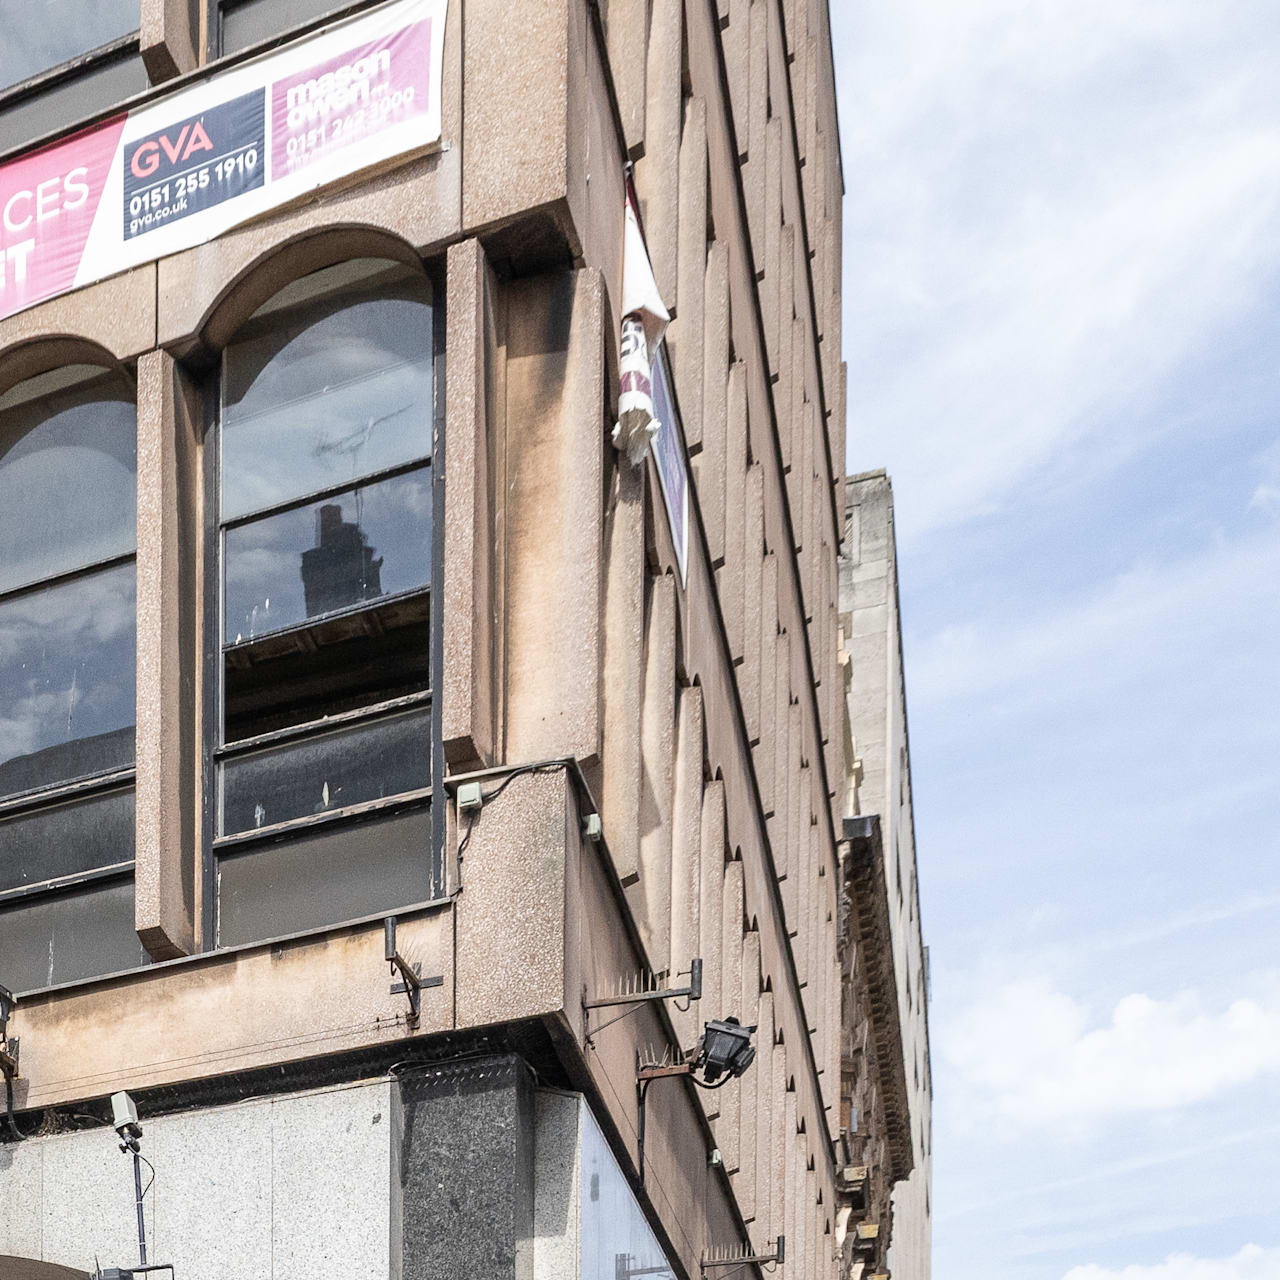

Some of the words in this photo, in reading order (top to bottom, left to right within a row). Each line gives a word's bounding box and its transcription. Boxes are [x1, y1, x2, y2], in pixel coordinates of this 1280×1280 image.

[130, 121, 214, 179] GVA
[130, 182, 169, 215] 0151
[175, 168, 210, 199] 255
[215, 149, 258, 182] 1910
[130, 197, 188, 234] gva.co.uk
